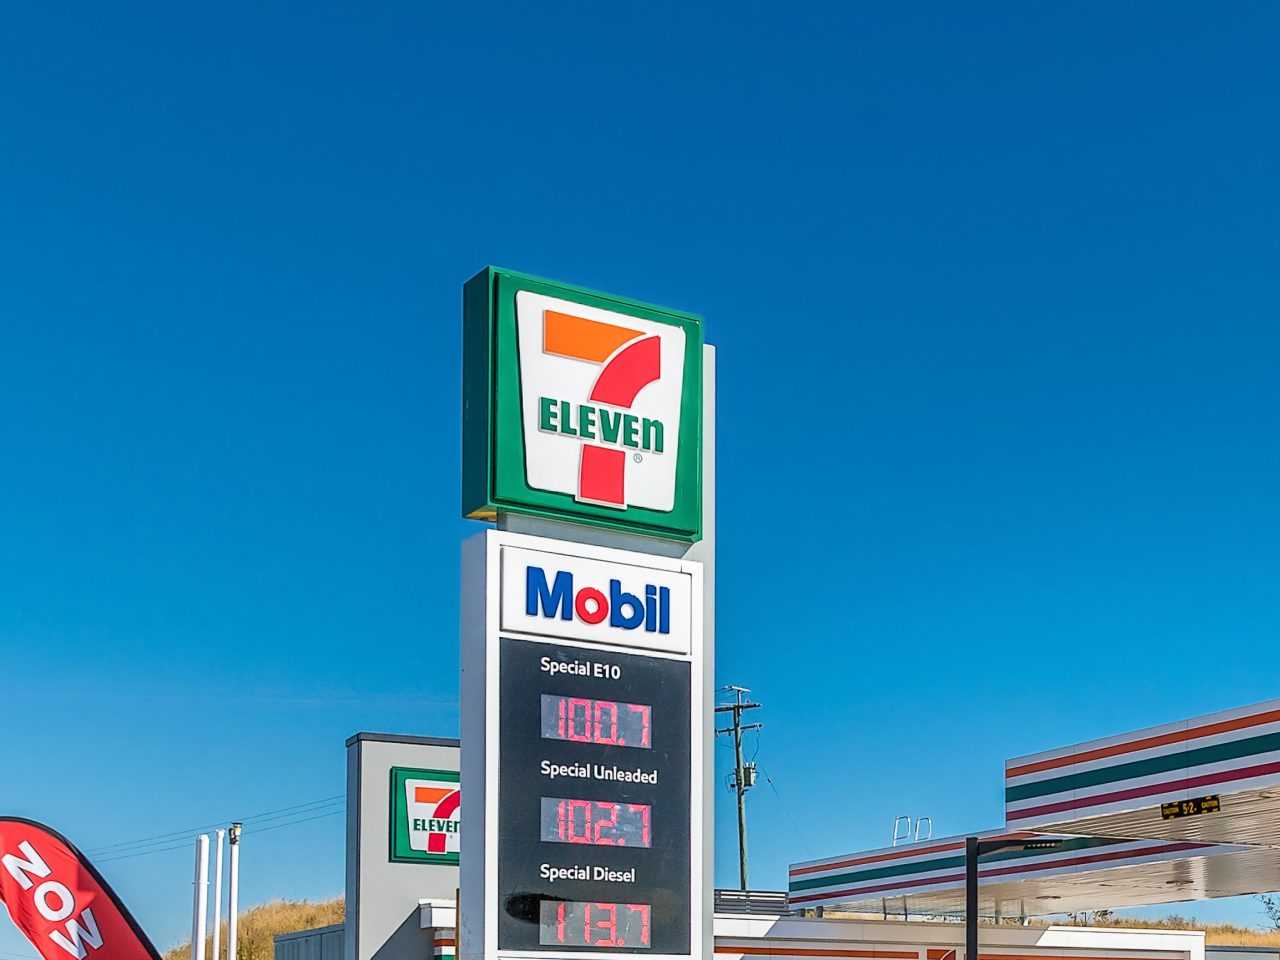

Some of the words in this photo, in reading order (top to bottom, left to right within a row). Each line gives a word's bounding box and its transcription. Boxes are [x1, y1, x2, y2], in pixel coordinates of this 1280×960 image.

[543, 309, 661, 505] 7
[526, 565, 670, 635] Mobil
[540, 656, 590, 676] Special
[593, 663, 621, 680] E10
[558, 697, 650, 747] 100.7
[540, 760, 590, 779] Special
[593, 765, 658, 784] Unleaded
[557, 799, 650, 848] 102.7
[540, 863, 590, 882] Special
[593, 866, 636, 882] Diesel
[2, 840, 104, 960] NOW
[556, 901, 650, 947] 113.7
